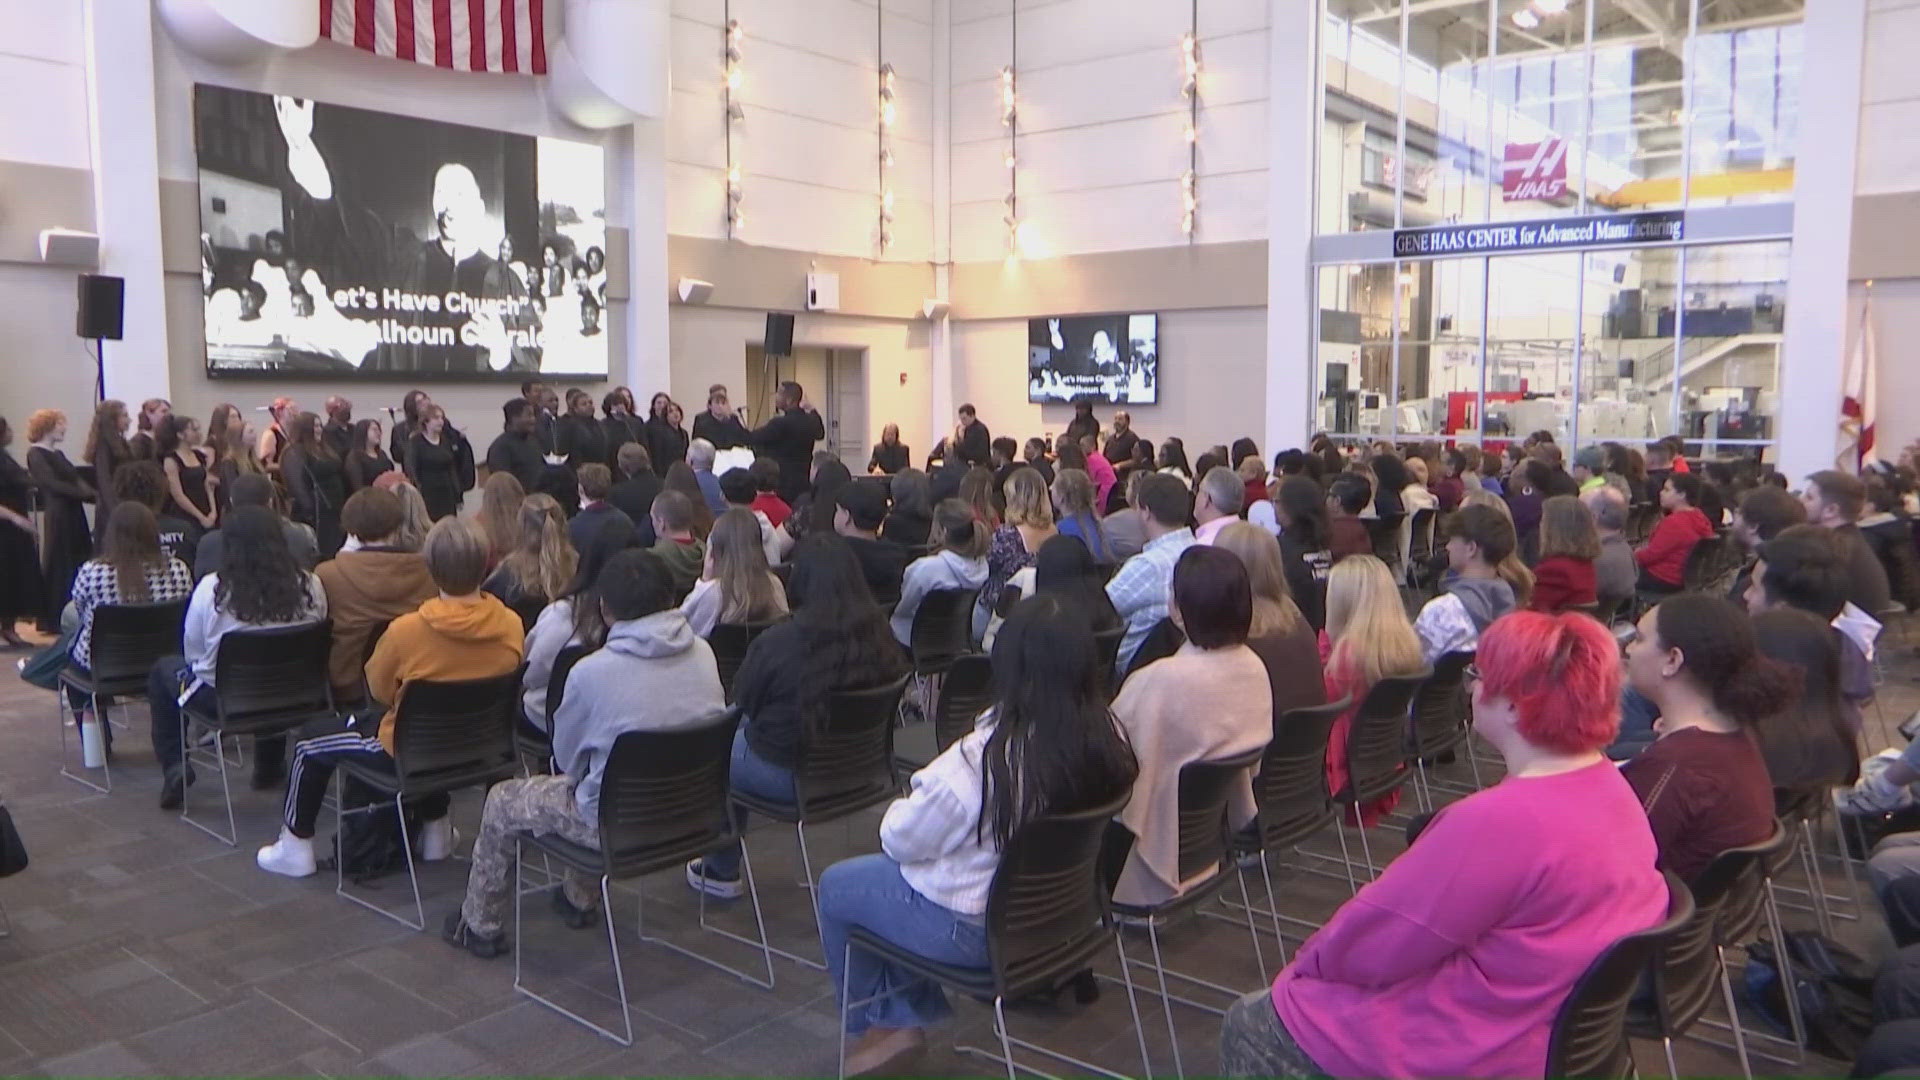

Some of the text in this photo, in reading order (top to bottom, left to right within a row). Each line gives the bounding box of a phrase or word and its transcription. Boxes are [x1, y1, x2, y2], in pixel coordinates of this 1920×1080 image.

[1506, 180, 1565, 199] HAAS
[1395, 215, 1682, 253] GENE HAAS CENTER for Advanced Manufacturing
[333, 286, 378, 309] et’s
[383, 288, 441, 312] Have
[352, 318, 455, 346] lhoun
